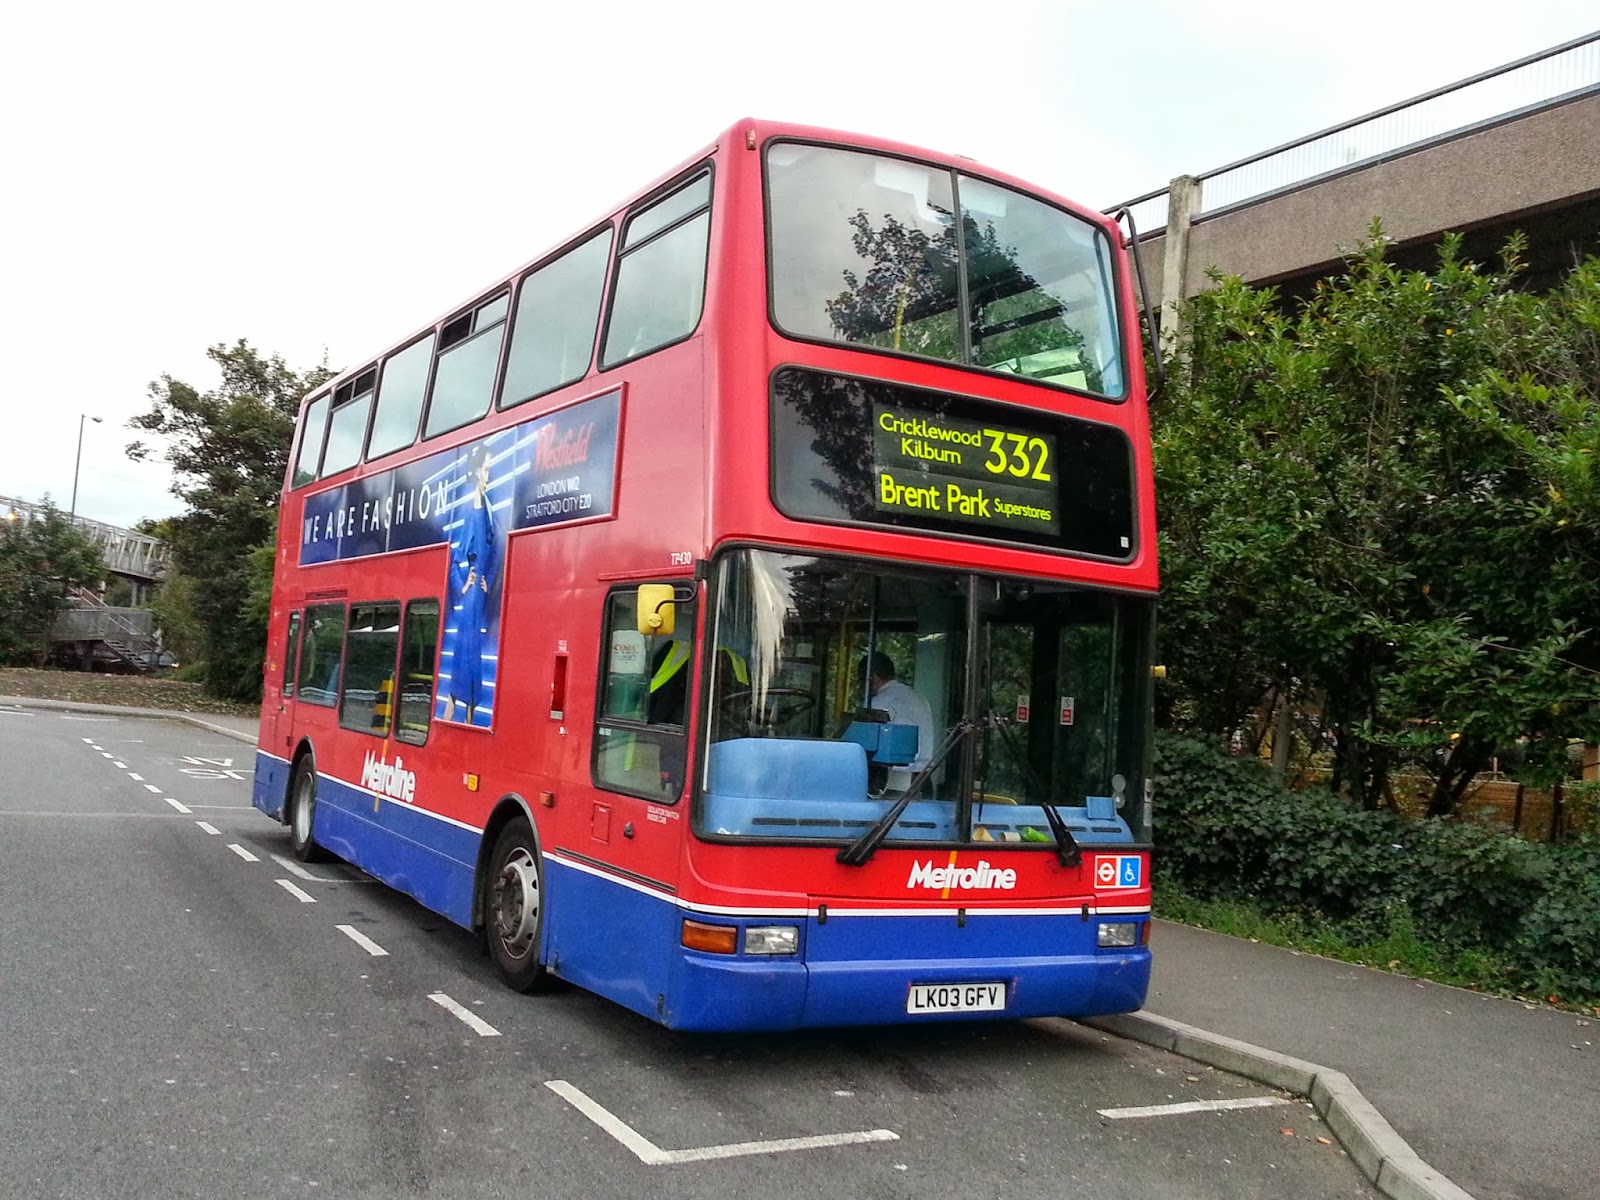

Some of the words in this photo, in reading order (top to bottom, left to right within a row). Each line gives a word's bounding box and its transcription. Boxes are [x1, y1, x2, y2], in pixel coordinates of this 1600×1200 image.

[879, 412, 981, 447] Cricklewood
[901, 437, 962, 465] Kilburn
[983, 428, 1051, 482] 332
[537, 479, 566, 499] LONDON
[881, 473, 941, 511] Brent
[947, 484, 991, 518] Park
[993, 497, 1052, 520] Superstores
[304, 515, 320, 545] WE
[324, 506, 356, 541] ARE
[361, 479, 450, 534] FASHION
[525, 499, 561, 519] STRATFORD
[562, 496, 579, 513] CITY
[579, 493, 592, 510] E20
[671, 551, 692, 566] TP430
[361, 749, 416, 803] Metroline
[906, 859, 1017, 890] Metroline
[915, 987, 960, 1009] LK03
[965, 986, 998, 1006] GFV
